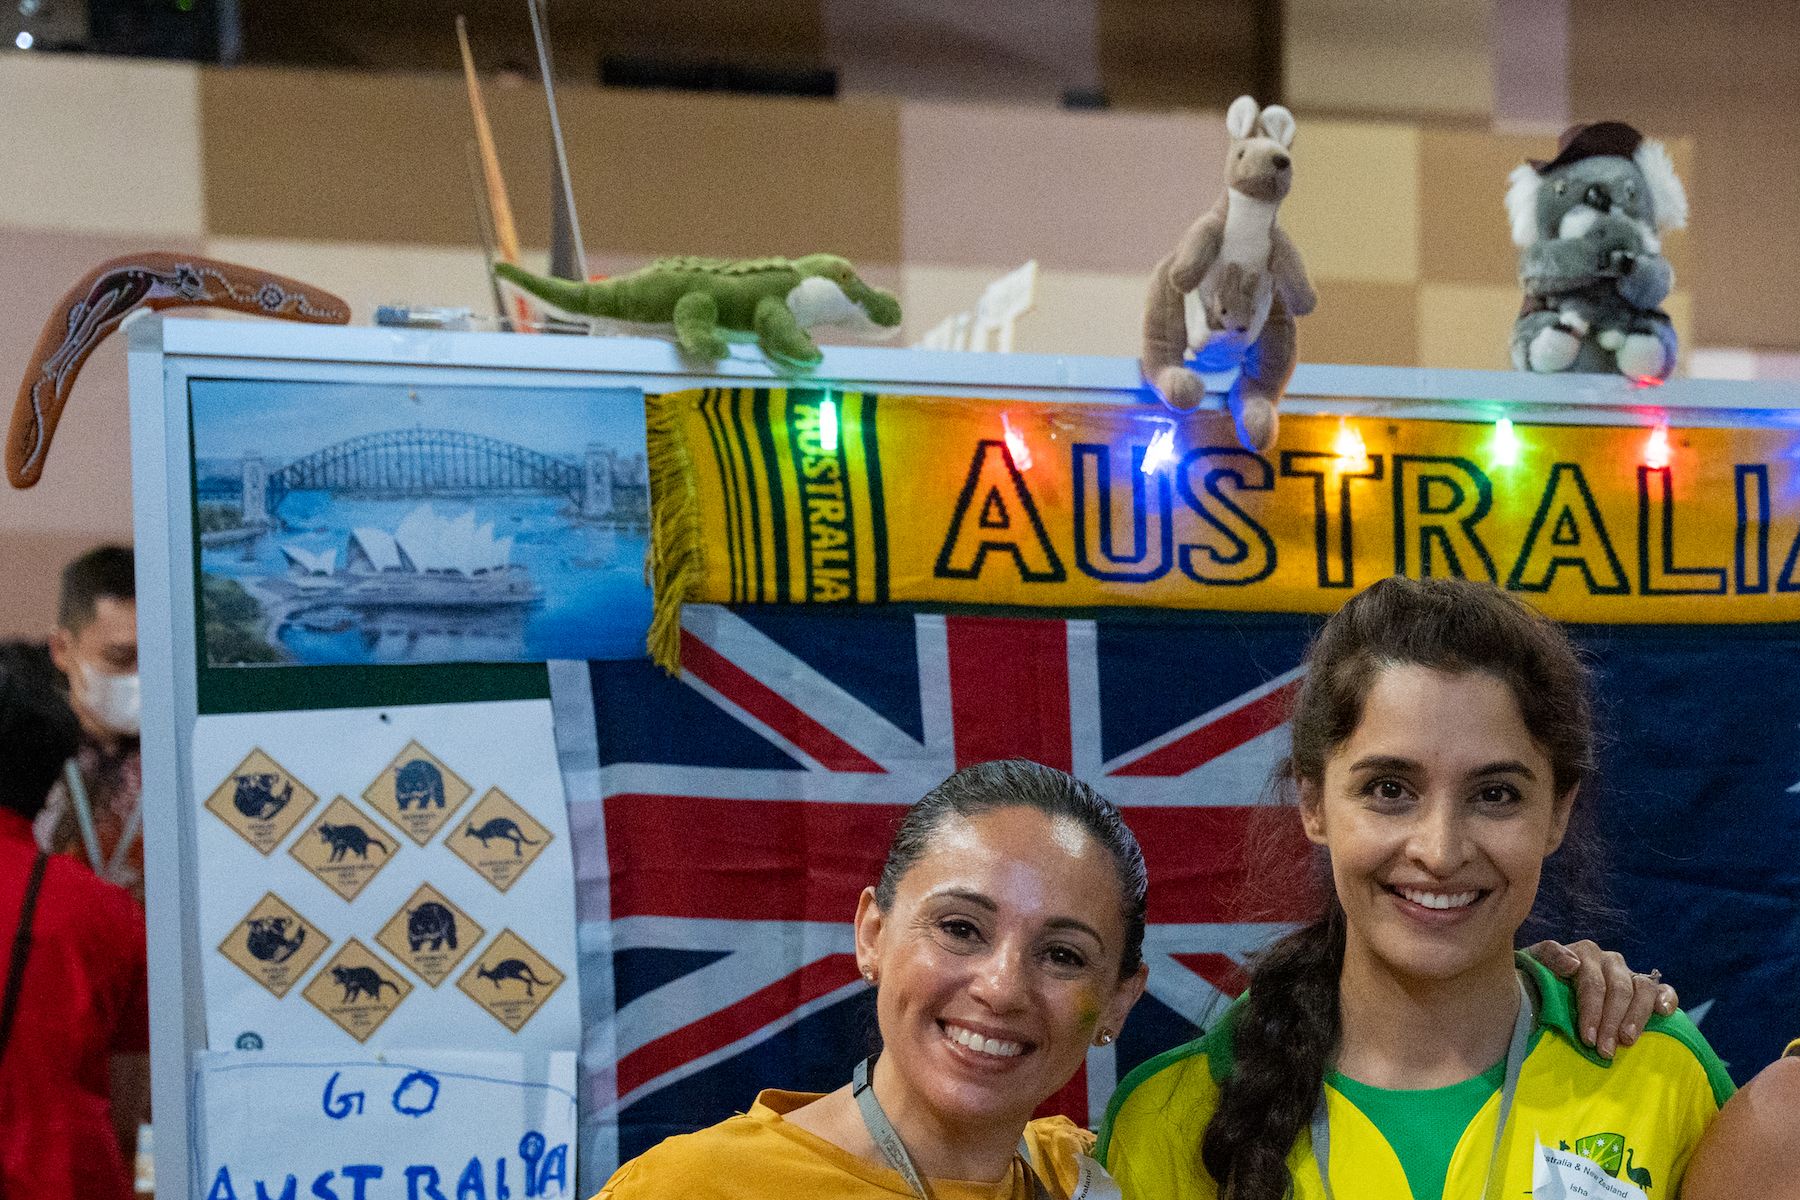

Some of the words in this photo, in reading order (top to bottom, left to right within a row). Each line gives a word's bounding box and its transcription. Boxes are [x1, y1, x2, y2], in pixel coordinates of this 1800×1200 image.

[323, 1071, 440, 1120] GO
[1574, 1163, 1582, 1172] &
[1583, 1166, 1599, 1181] New
[1597, 1177, 1629, 1199] Zealand
